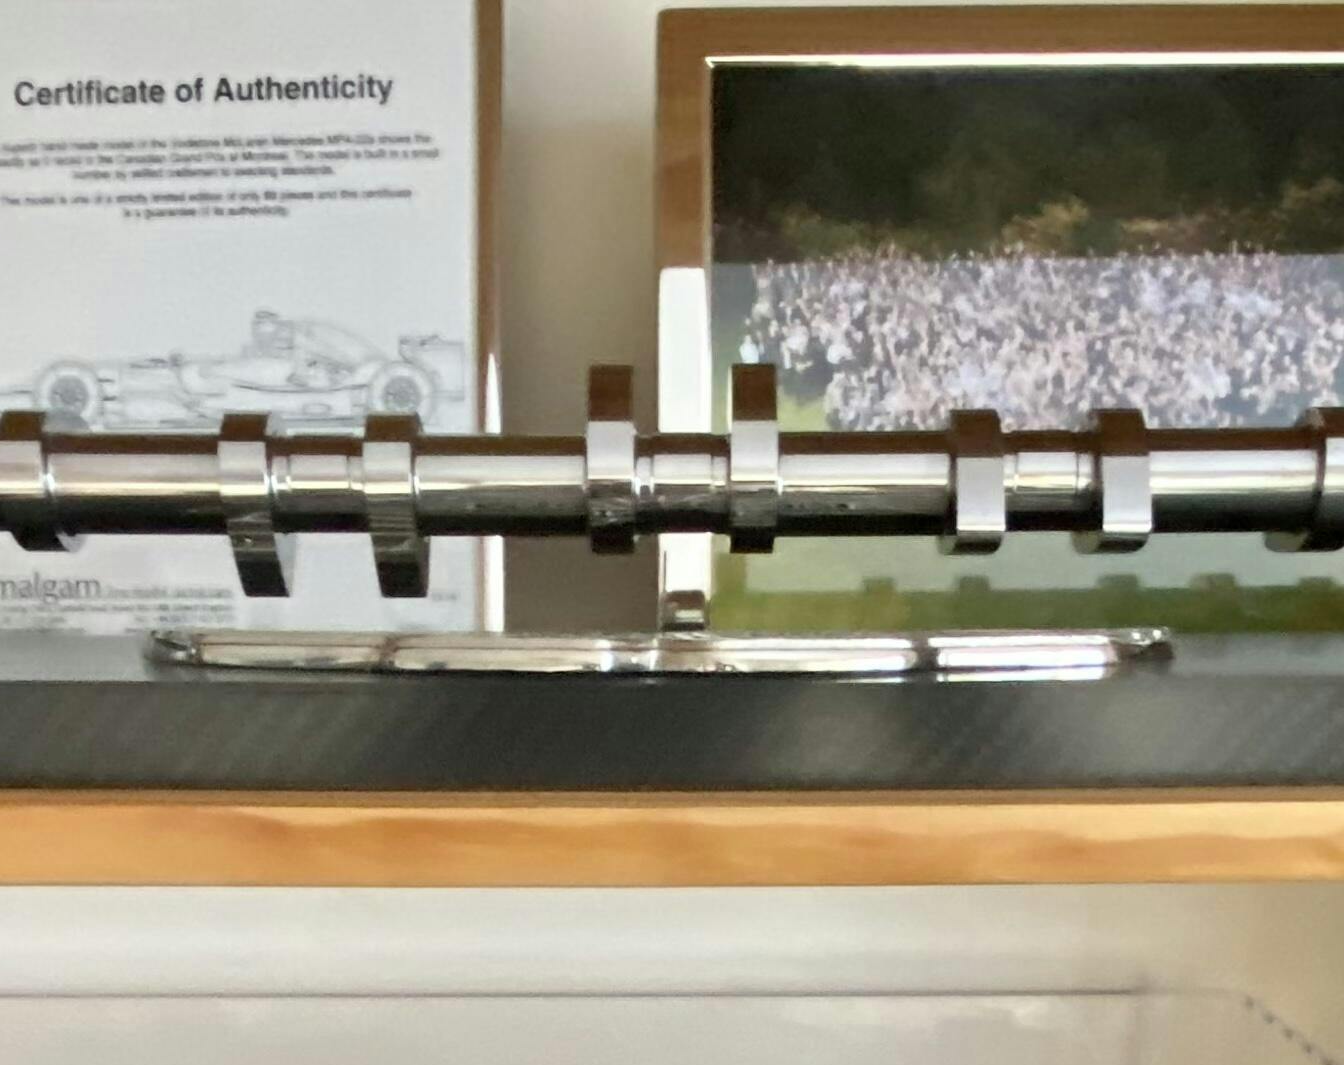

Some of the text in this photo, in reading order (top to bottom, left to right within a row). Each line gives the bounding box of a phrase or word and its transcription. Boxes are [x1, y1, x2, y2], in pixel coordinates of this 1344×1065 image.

[14, 73, 393, 107] Certificate of Authenticity
